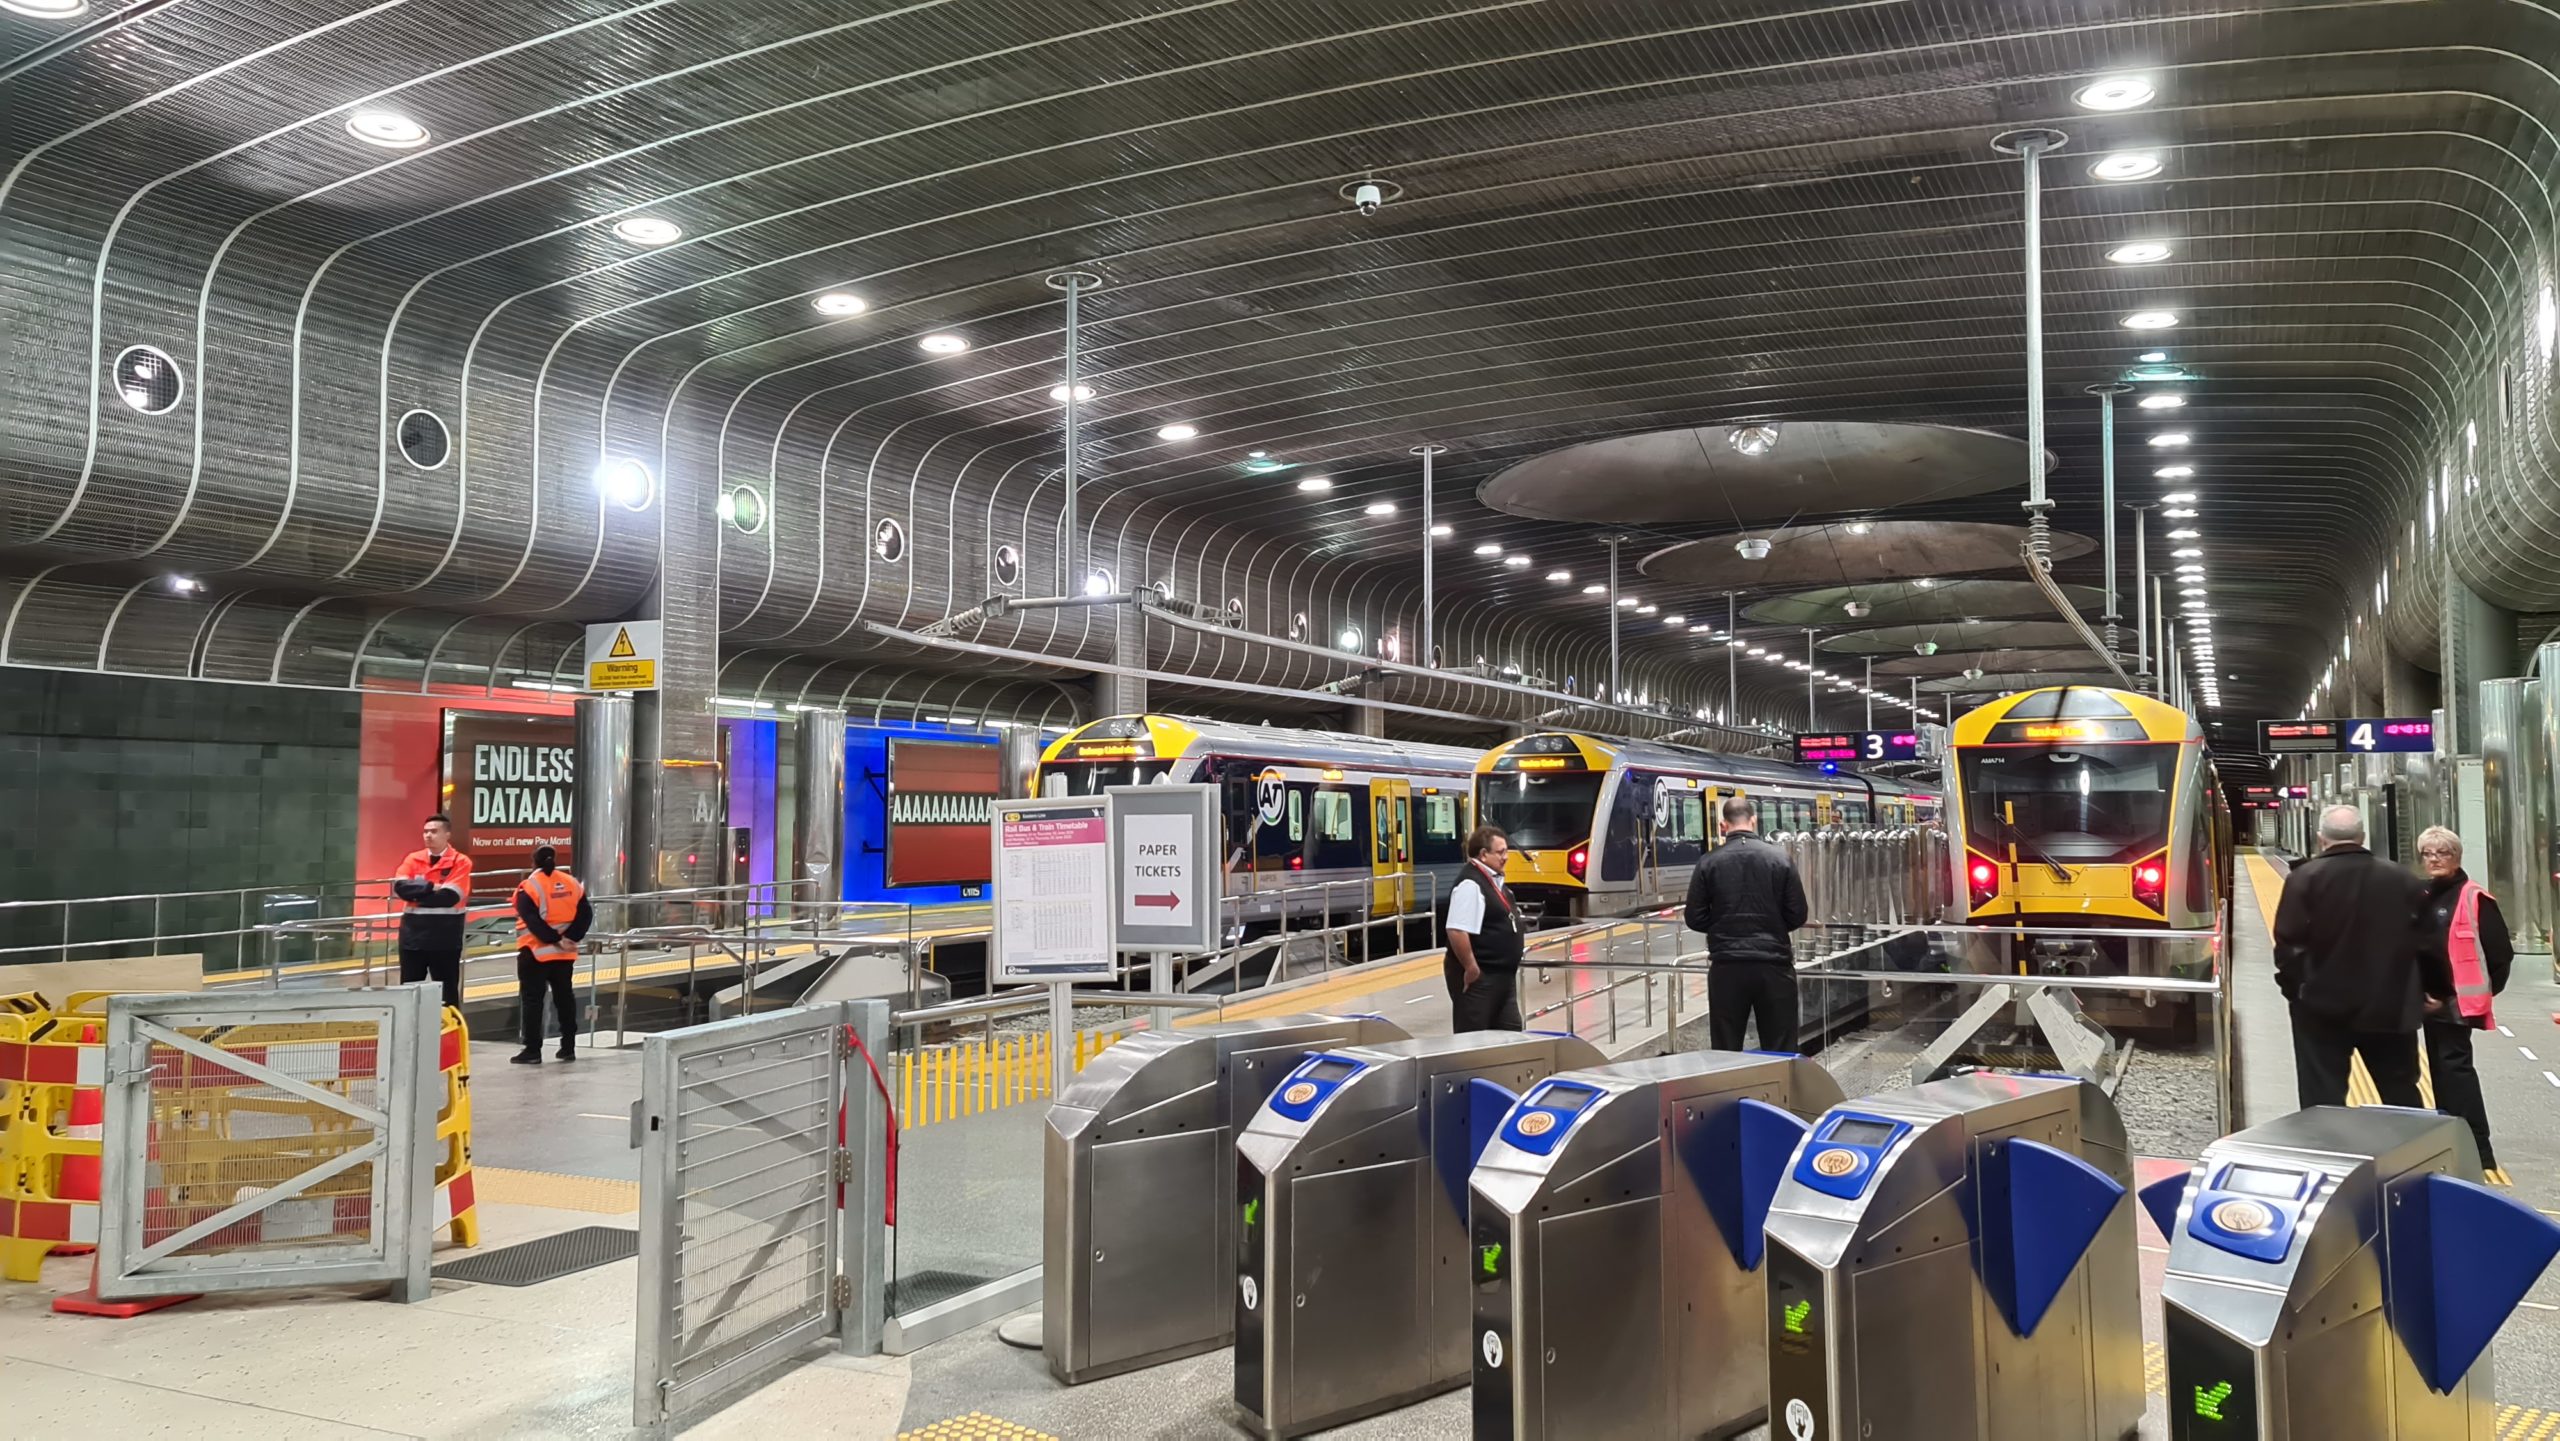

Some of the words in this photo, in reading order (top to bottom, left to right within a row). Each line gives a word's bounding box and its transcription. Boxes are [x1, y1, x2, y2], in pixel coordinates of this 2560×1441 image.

[606, 663, 638, 673] Warning
[2350, 723, 2376, 750] 4
[1866, 734, 1884, 759] 3
[474, 744, 574, 783] ENDLESS
[1005, 825, 1017, 833] Rail
[1019, 824, 1031, 832] Bus
[1039, 823, 1054, 831] Train
[1056, 821, 1088, 830] Timetable
[472, 837, 491, 846] Now
[492, 838, 503, 846] on
[505, 837, 515, 846] all
[516, 838, 533, 846] new
[1139, 844, 1177, 856] PAPER
[1134, 865, 1181, 877] TICKETS
